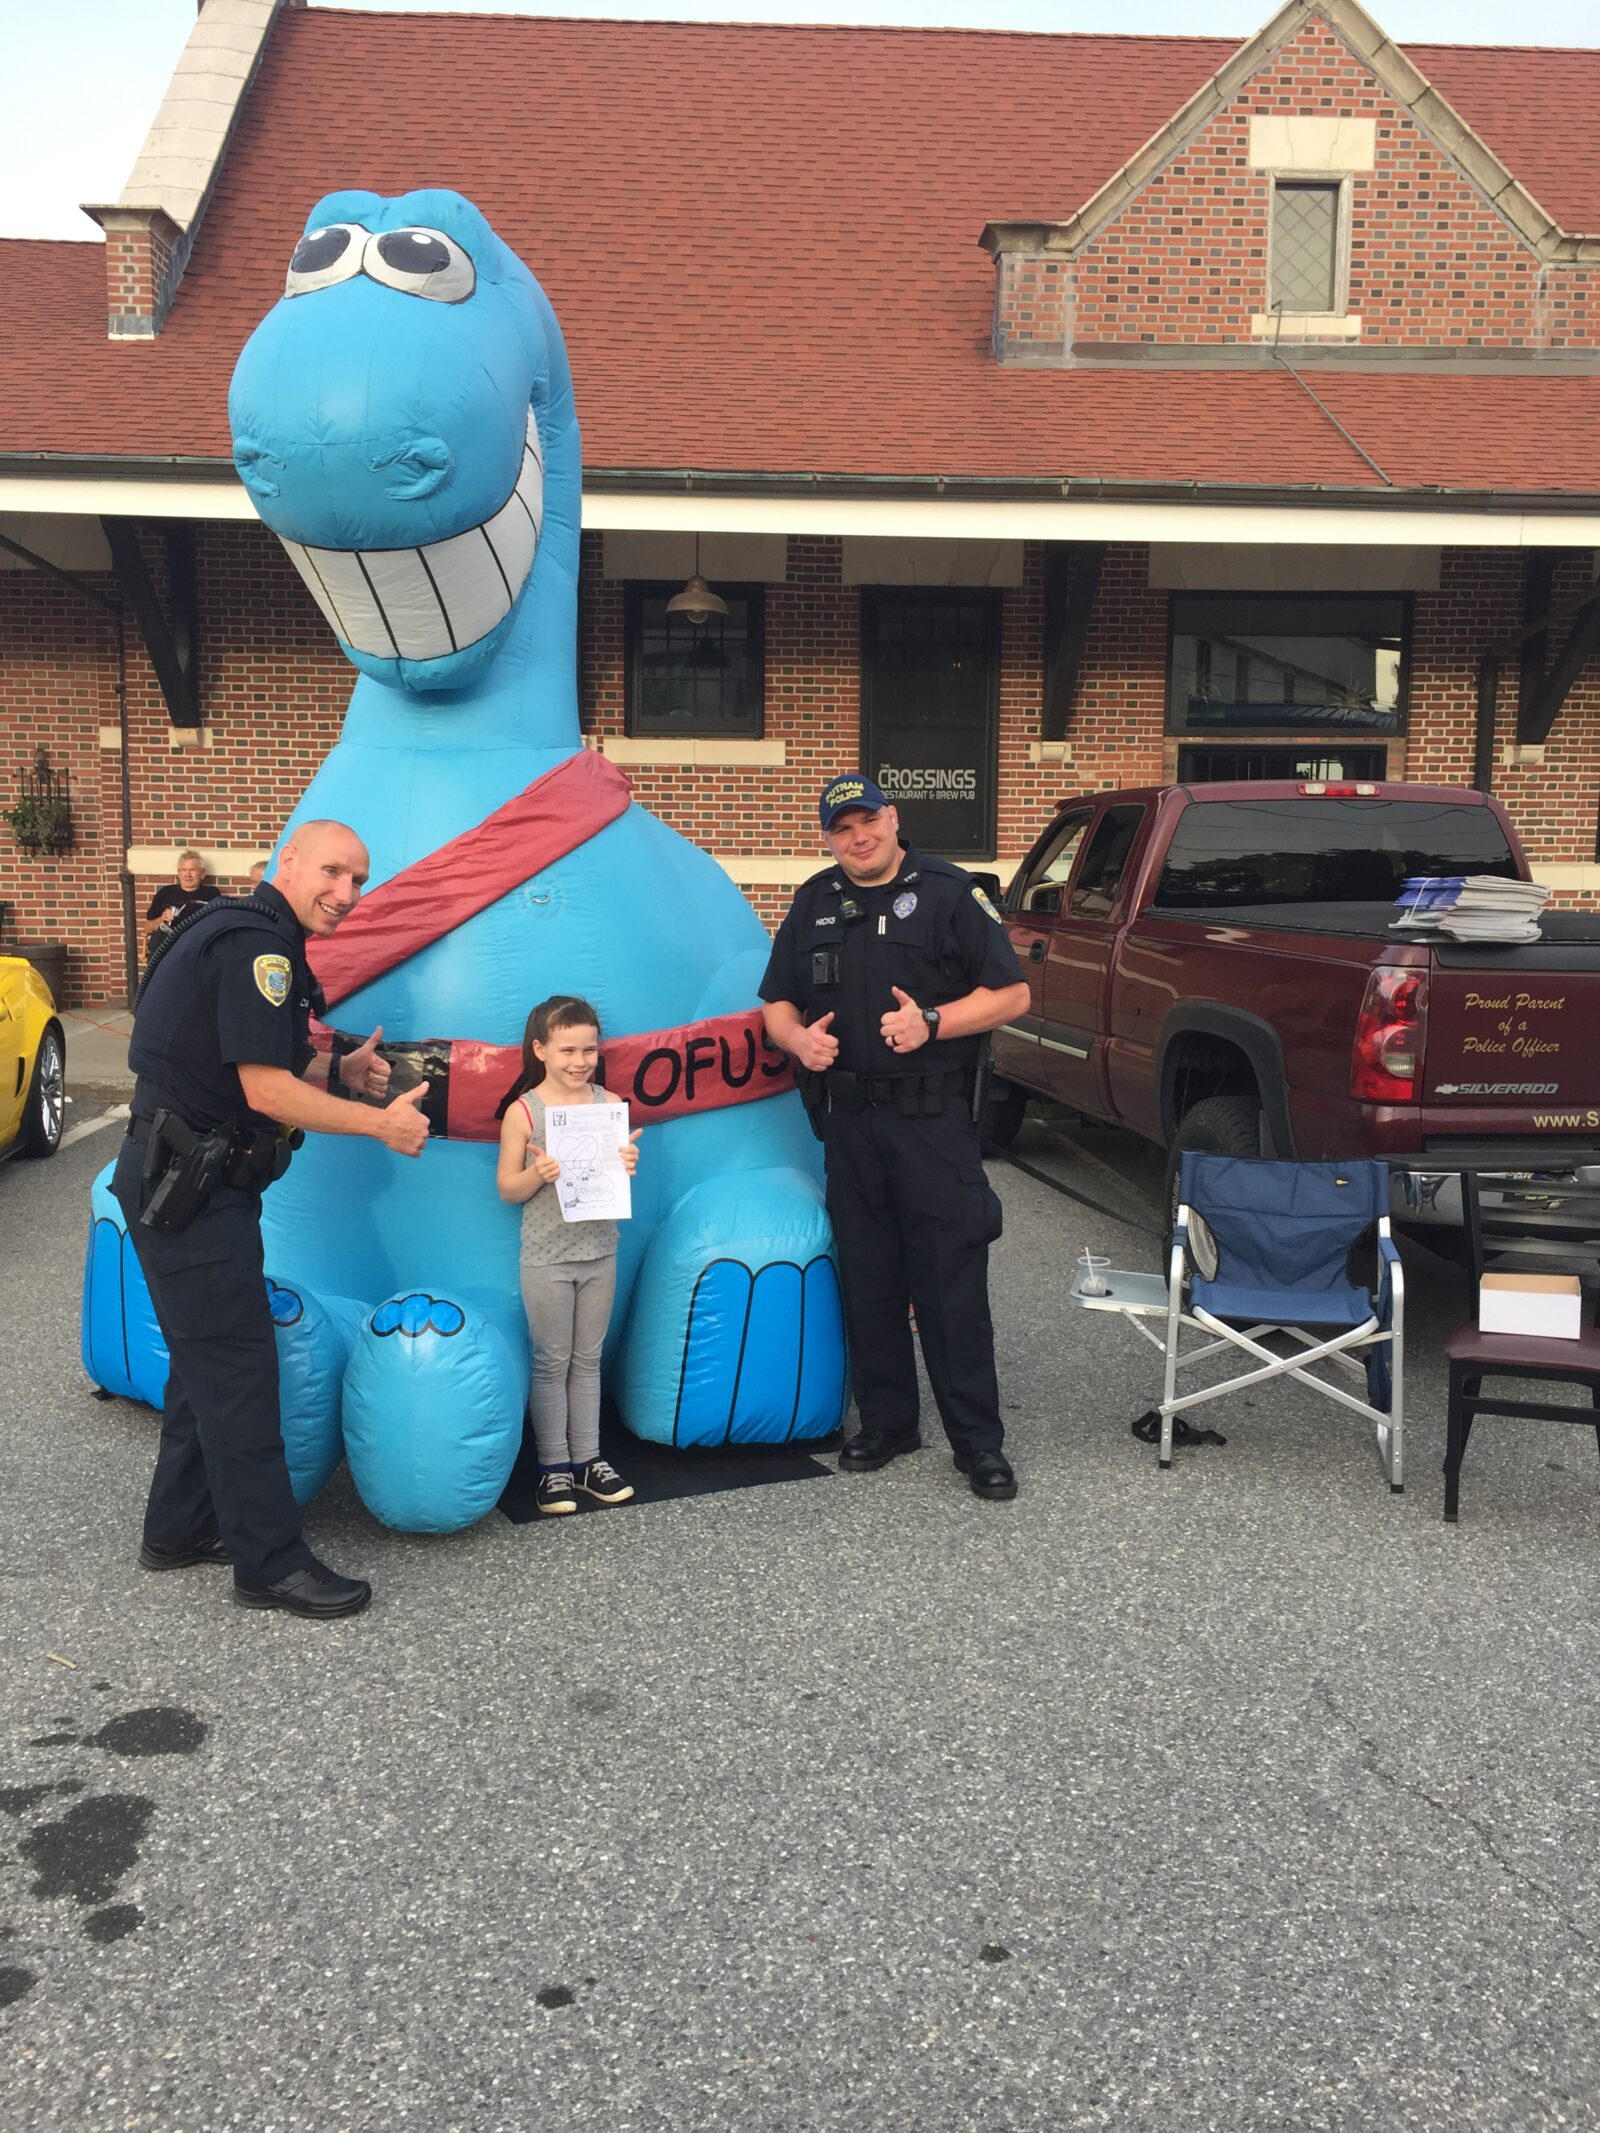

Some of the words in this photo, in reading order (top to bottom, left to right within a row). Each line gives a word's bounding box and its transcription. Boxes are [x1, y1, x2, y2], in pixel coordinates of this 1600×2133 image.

[878, 768, 976, 789] CROSSINGS
[825, 781, 864, 804] PUTNAM
[830, 789, 863, 808] POLICE
[929, 790, 935, 799] &
[936, 790, 959, 799] BREW
[960, 790, 976, 800] PUB
[815, 916, 836, 926] HICKS
[1464, 993, 1512, 1011] Proud
[1515, 993, 1566, 1011] Parent
[1498, 1016, 1513, 1035] of
[1518, 1020, 1528, 1031] a
[1462, 1036, 1507, 1054] Police
[1511, 1036, 1561, 1058] Officer
[1457, 1082, 1559, 1095] SILVERADO
